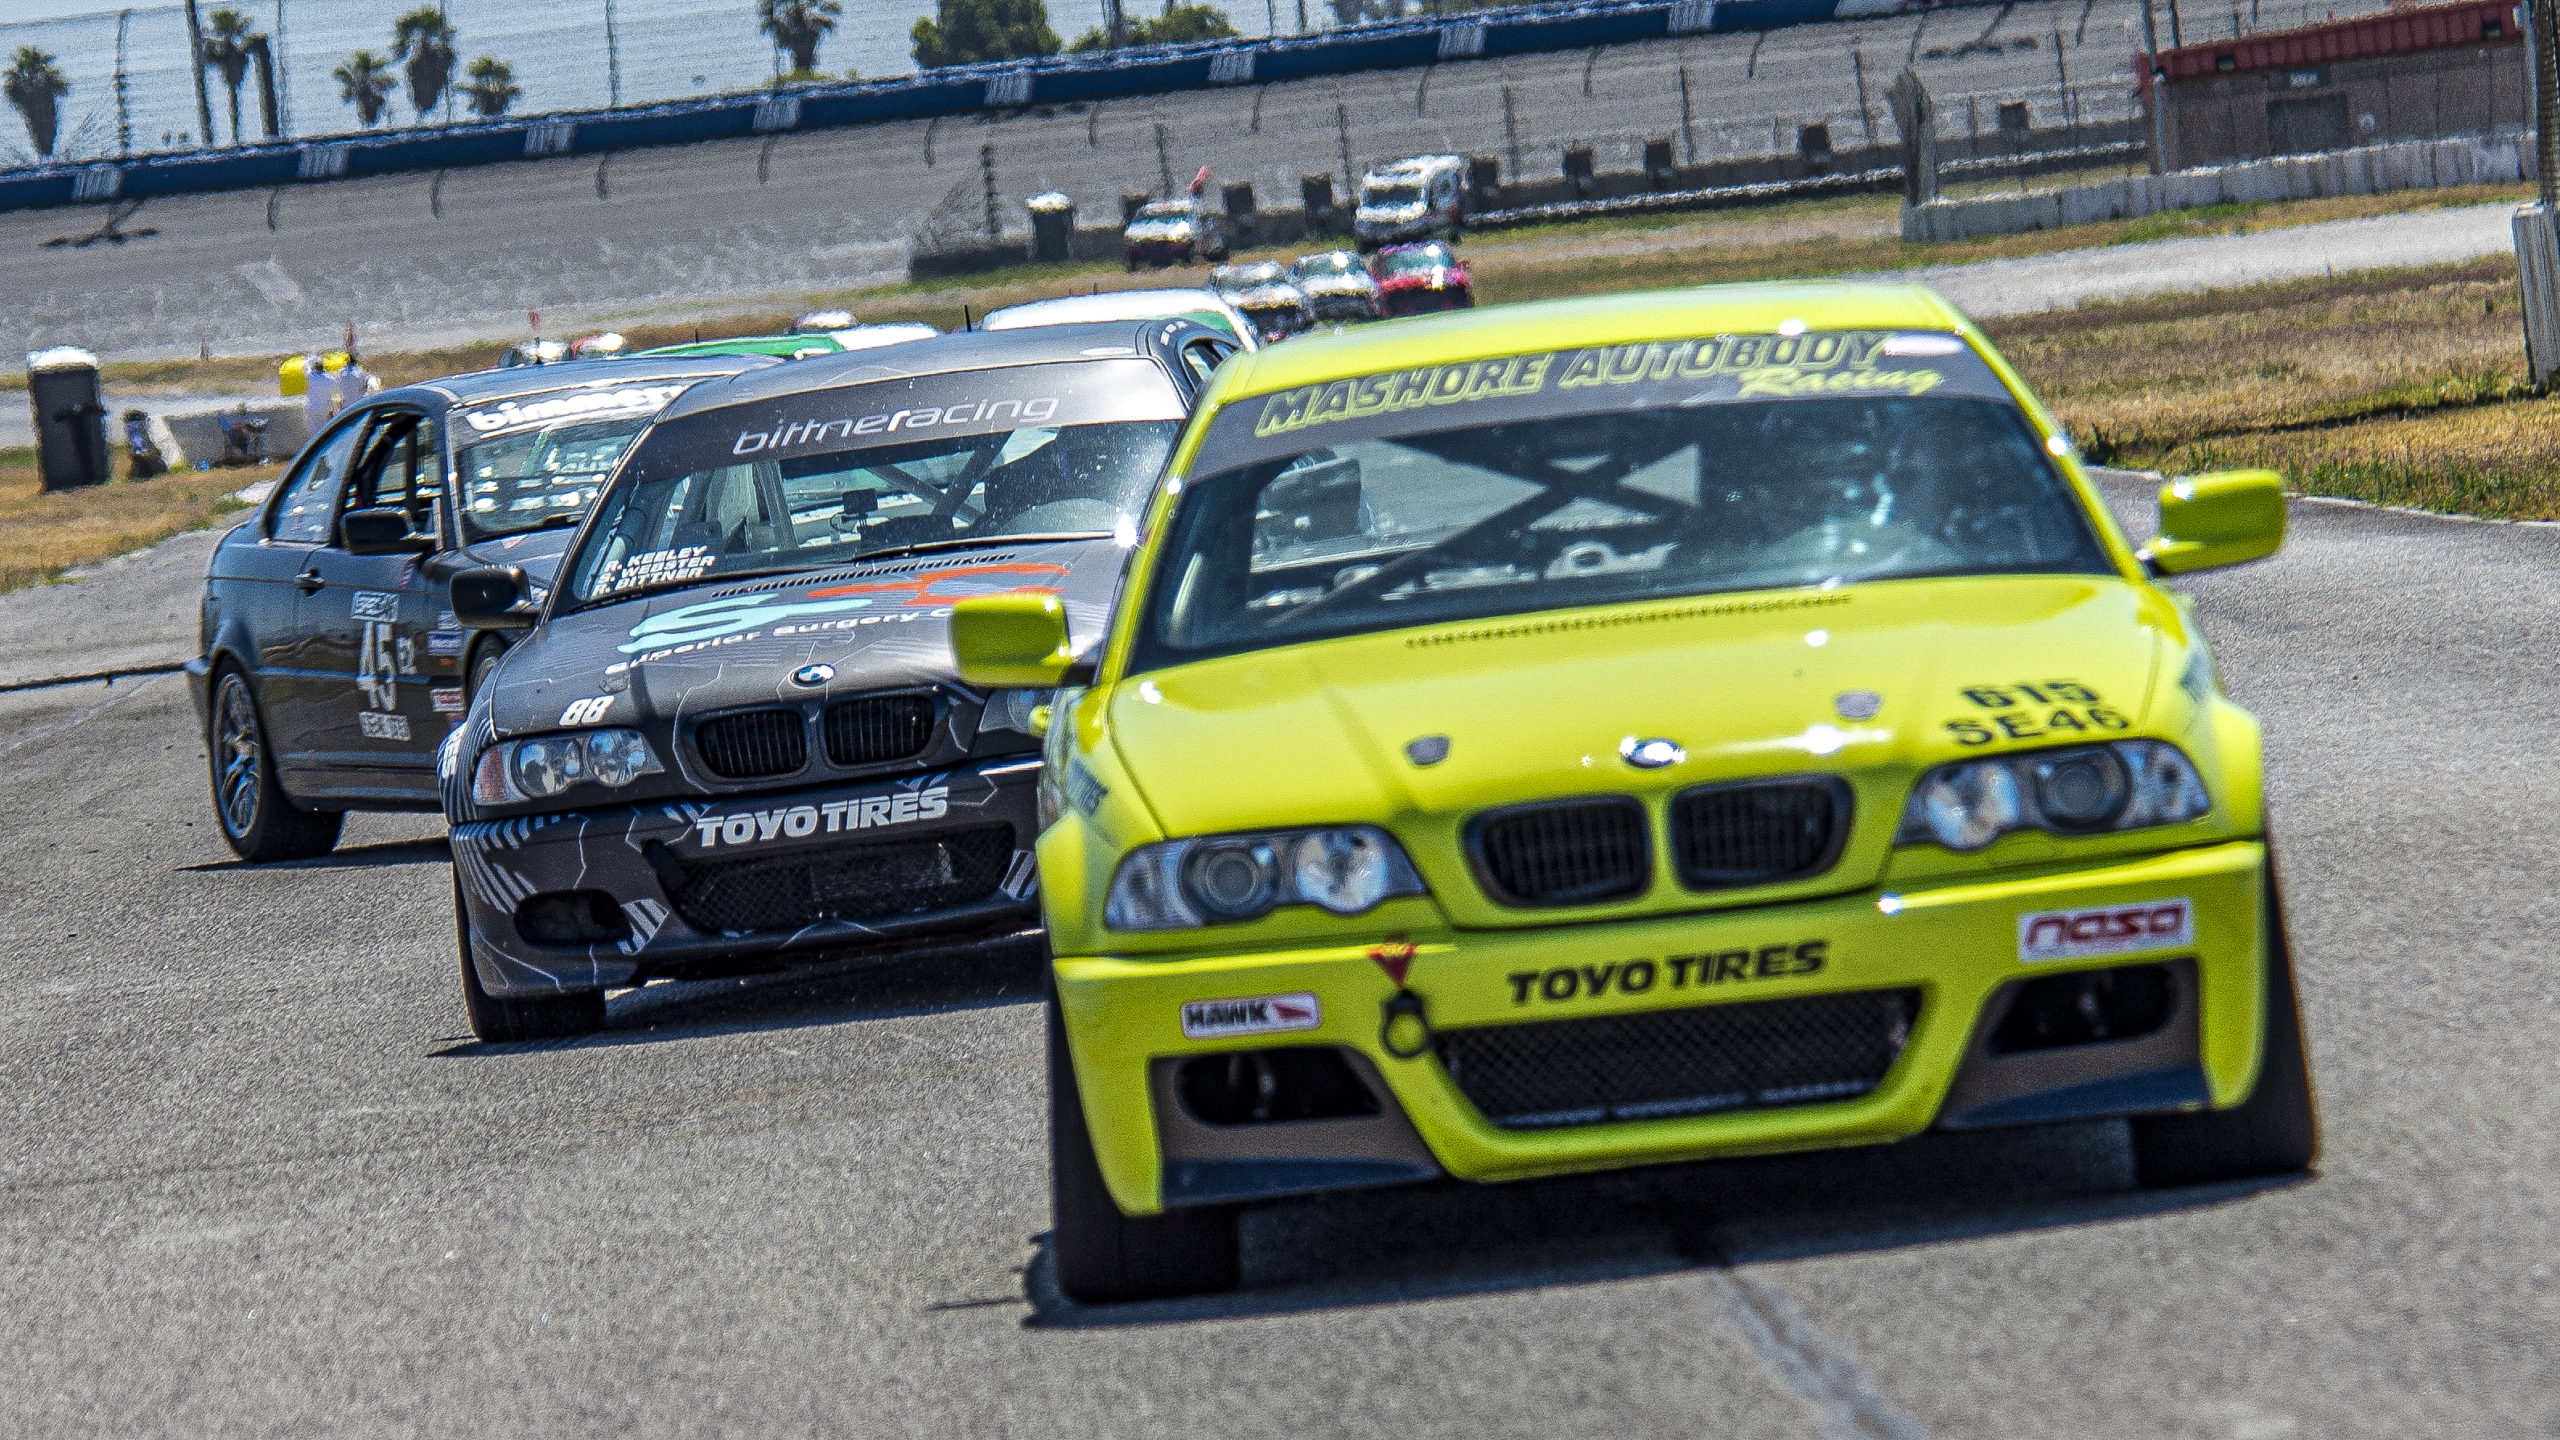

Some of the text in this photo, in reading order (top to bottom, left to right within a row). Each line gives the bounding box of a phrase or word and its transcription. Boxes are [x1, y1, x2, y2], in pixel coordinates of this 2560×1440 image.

[1254, 330, 1897, 438] MASHORE AUTOBODY
[1737, 366, 1945, 399] Racing
[732, 397, 1060, 455] bittneracing
[621, 555, 716, 579] WEBSTER
[627, 545, 708, 567] KEELEY
[614, 567, 704, 591] BITTNER
[356, 620, 397, 712] 45
[559, 695, 614, 726] 88
[1960, 680, 2100, 709] 615
[1945, 707, 2129, 746] SE46
[697, 786, 949, 847] TOYO TIRES
[1508, 939, 1829, 1006] TOYO TIRES
[1187, 998, 1269, 1027] HAWK
